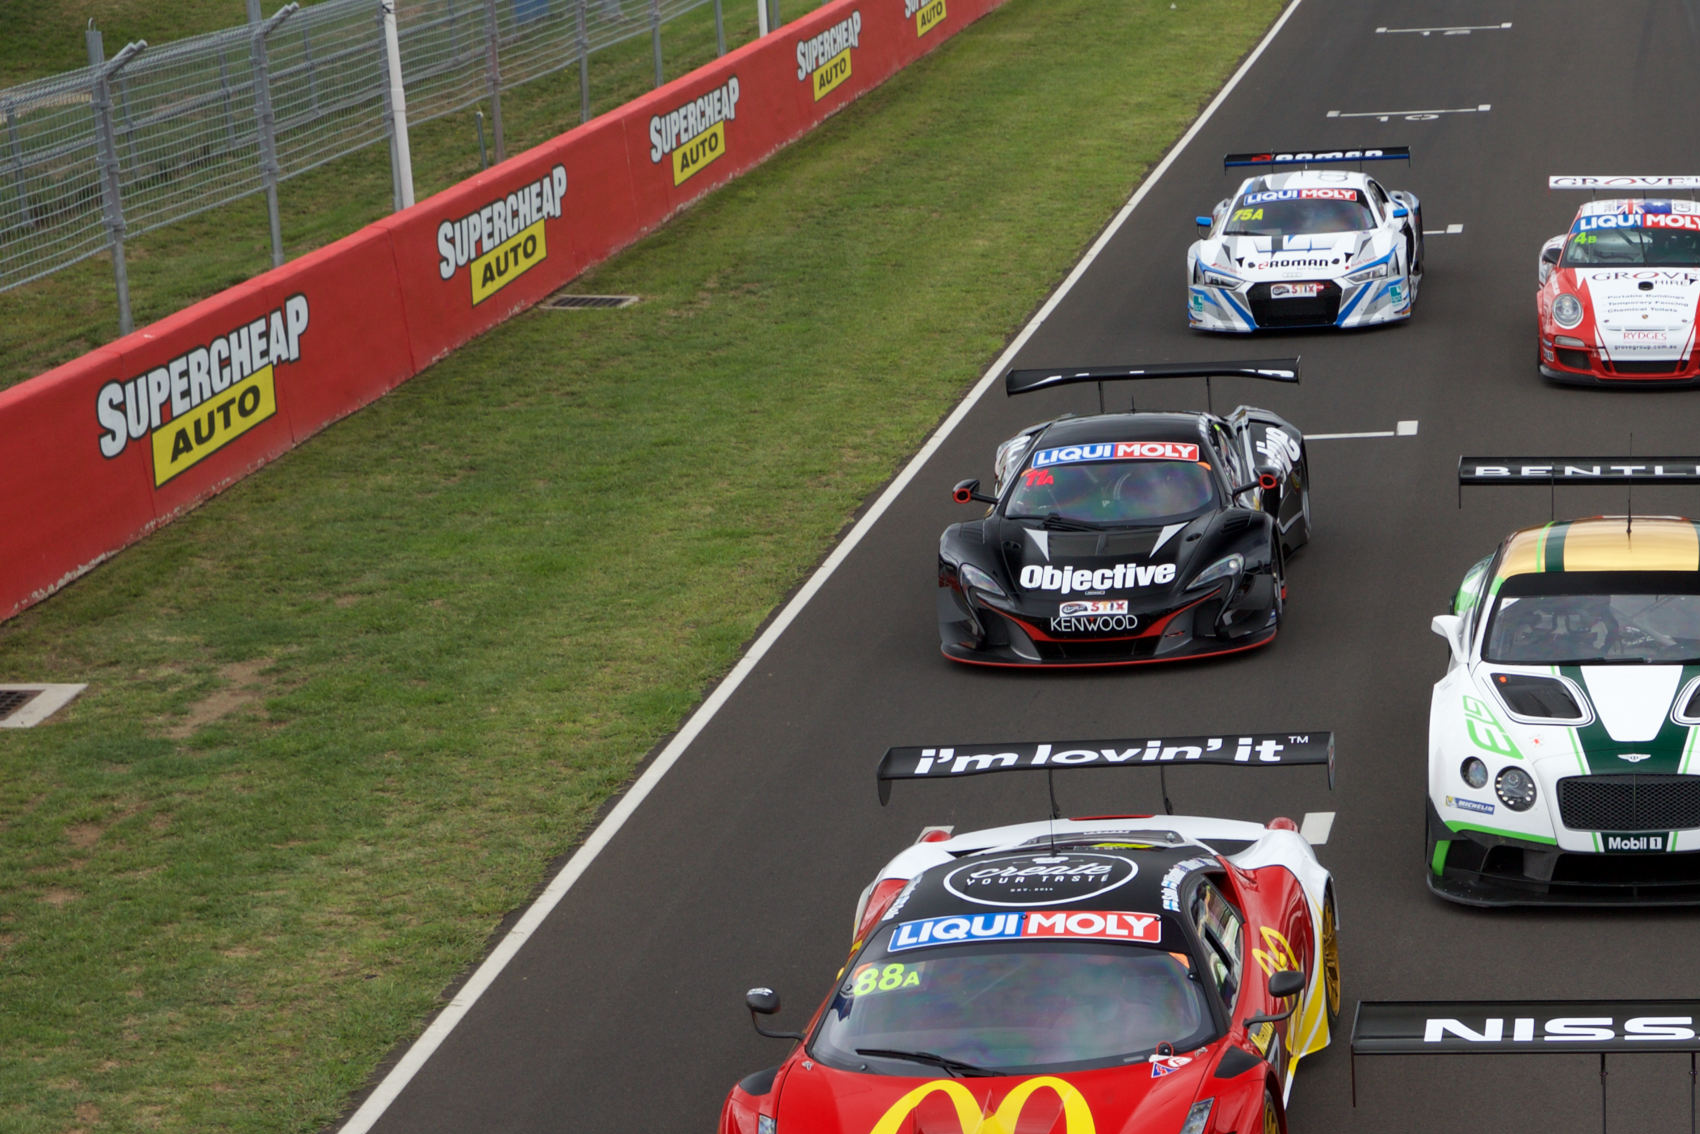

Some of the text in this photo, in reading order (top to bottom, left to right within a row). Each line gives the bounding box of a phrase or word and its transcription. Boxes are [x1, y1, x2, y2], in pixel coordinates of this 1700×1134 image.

[919, 1, 944, 28] AUTO
[797, 10, 861, 81] SUPERCHEAP
[818, 57, 847, 91] AUTO
[650, 76, 740, 163] SUPERCHEAP
[680, 131, 719, 173] AUTO
[1553, 177, 1686, 185] GROVE
[1247, 188, 1355, 203] LIQUI MOLY
[437, 164, 568, 281] SUPERCHEAP
[1232, 208, 1264, 222] 75A
[1580, 214, 1641, 230] LIQUI
[1574, 231, 1598, 245] 4B
[480, 234, 538, 290] AUTO
[1592, 271, 1700, 280] GROVE
[1623, 332, 1667, 340] RYDGES
[97, 293, 309, 458] SUPERCHEAP
[170, 384, 261, 463] AUTO
[1037, 445, 1112, 466] LIQUI
[1116, 444, 1197, 460] MOLY
[1019, 563, 1176, 595] Objective
[1090, 600, 1126, 612] STIX
[1050, 614, 1138, 632] KENWOOD
[914, 746, 1019, 774] i'm
[1030, 737, 1224, 765] lovin'
[1608, 836, 1662, 851] Mobil 1
[966, 874, 1110, 886] YOUR TASTE
[970, 863, 1113, 878] create
[896, 913, 1160, 945] LIQUI MOLY
[853, 962, 920, 996] 88A
